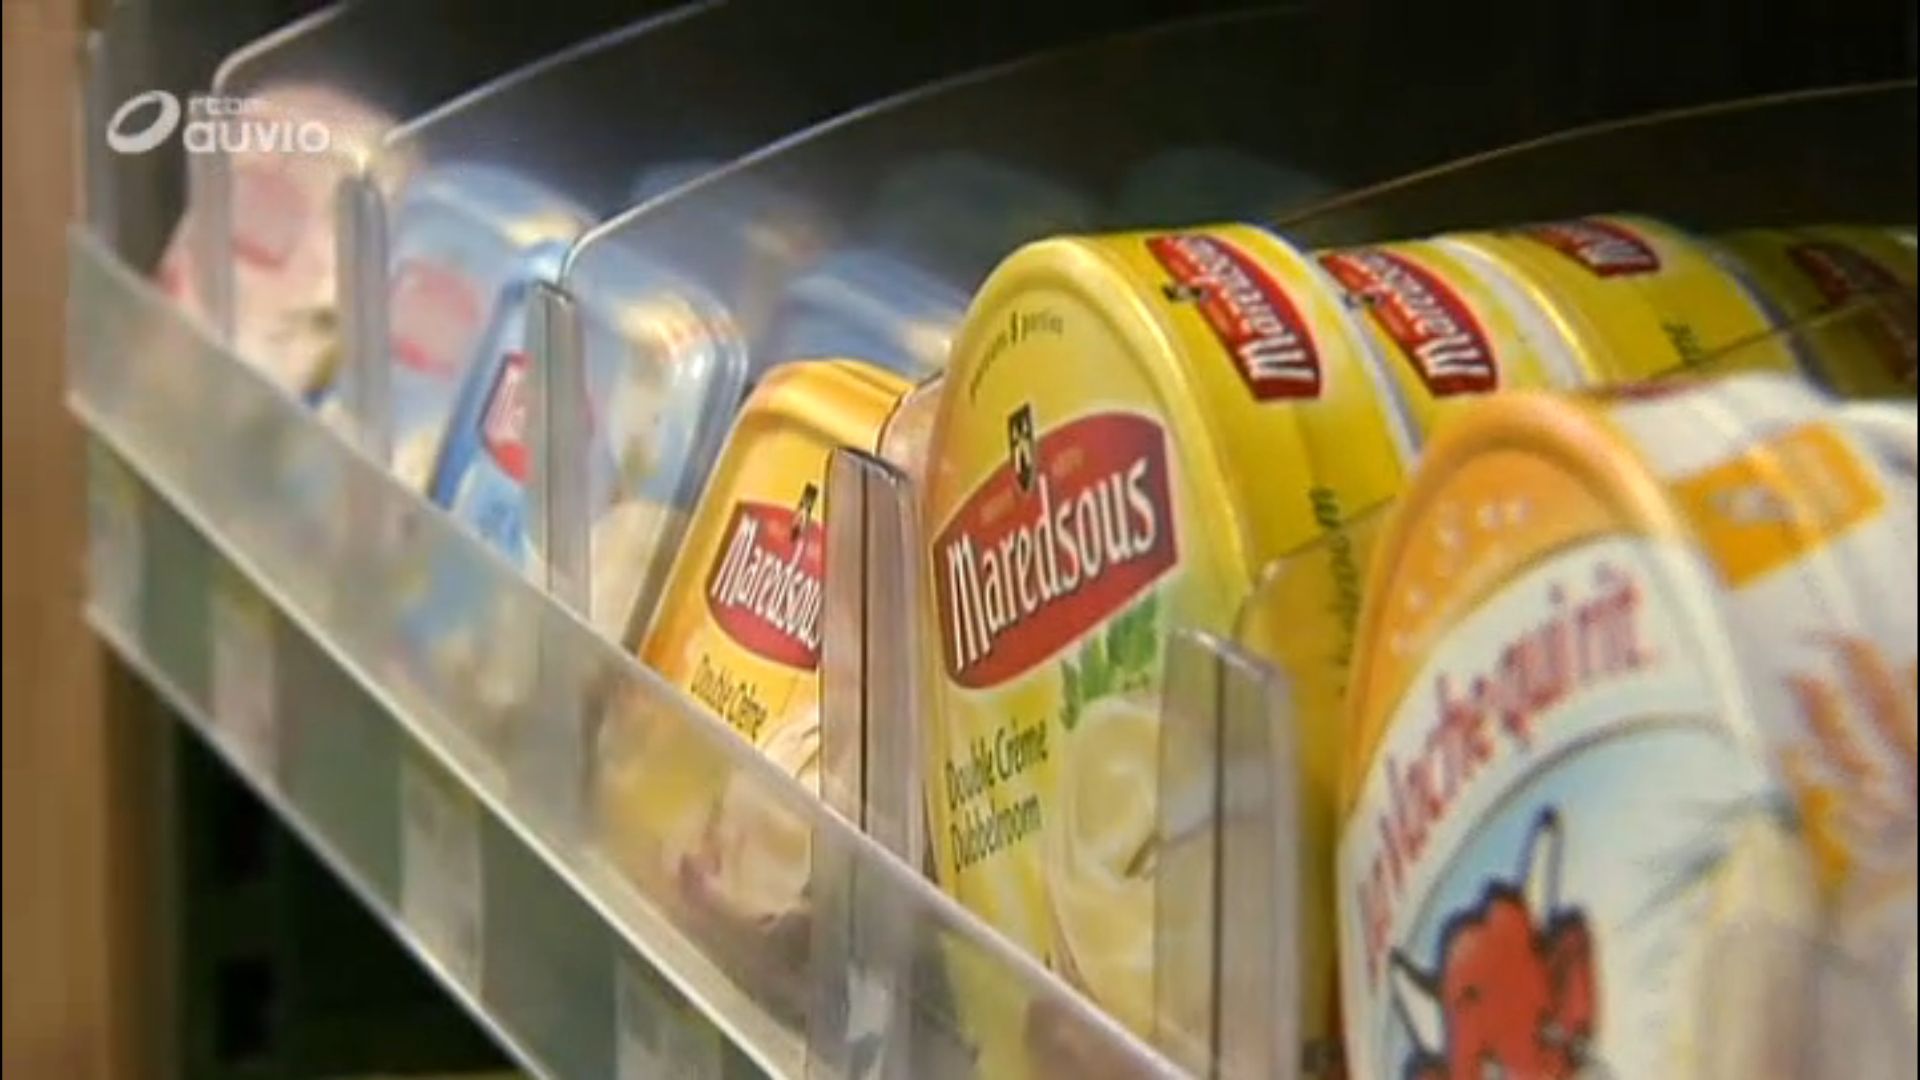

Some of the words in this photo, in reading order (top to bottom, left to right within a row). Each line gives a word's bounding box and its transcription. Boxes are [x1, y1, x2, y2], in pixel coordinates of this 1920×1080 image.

[710, 512, 824, 650] Maredsou
[946, 457, 1156, 672] Maredsous
[946, 735, 996, 811] Double
[995, 716, 1049, 781] Crème
[950, 793, 1043, 874] Dubbelroom
